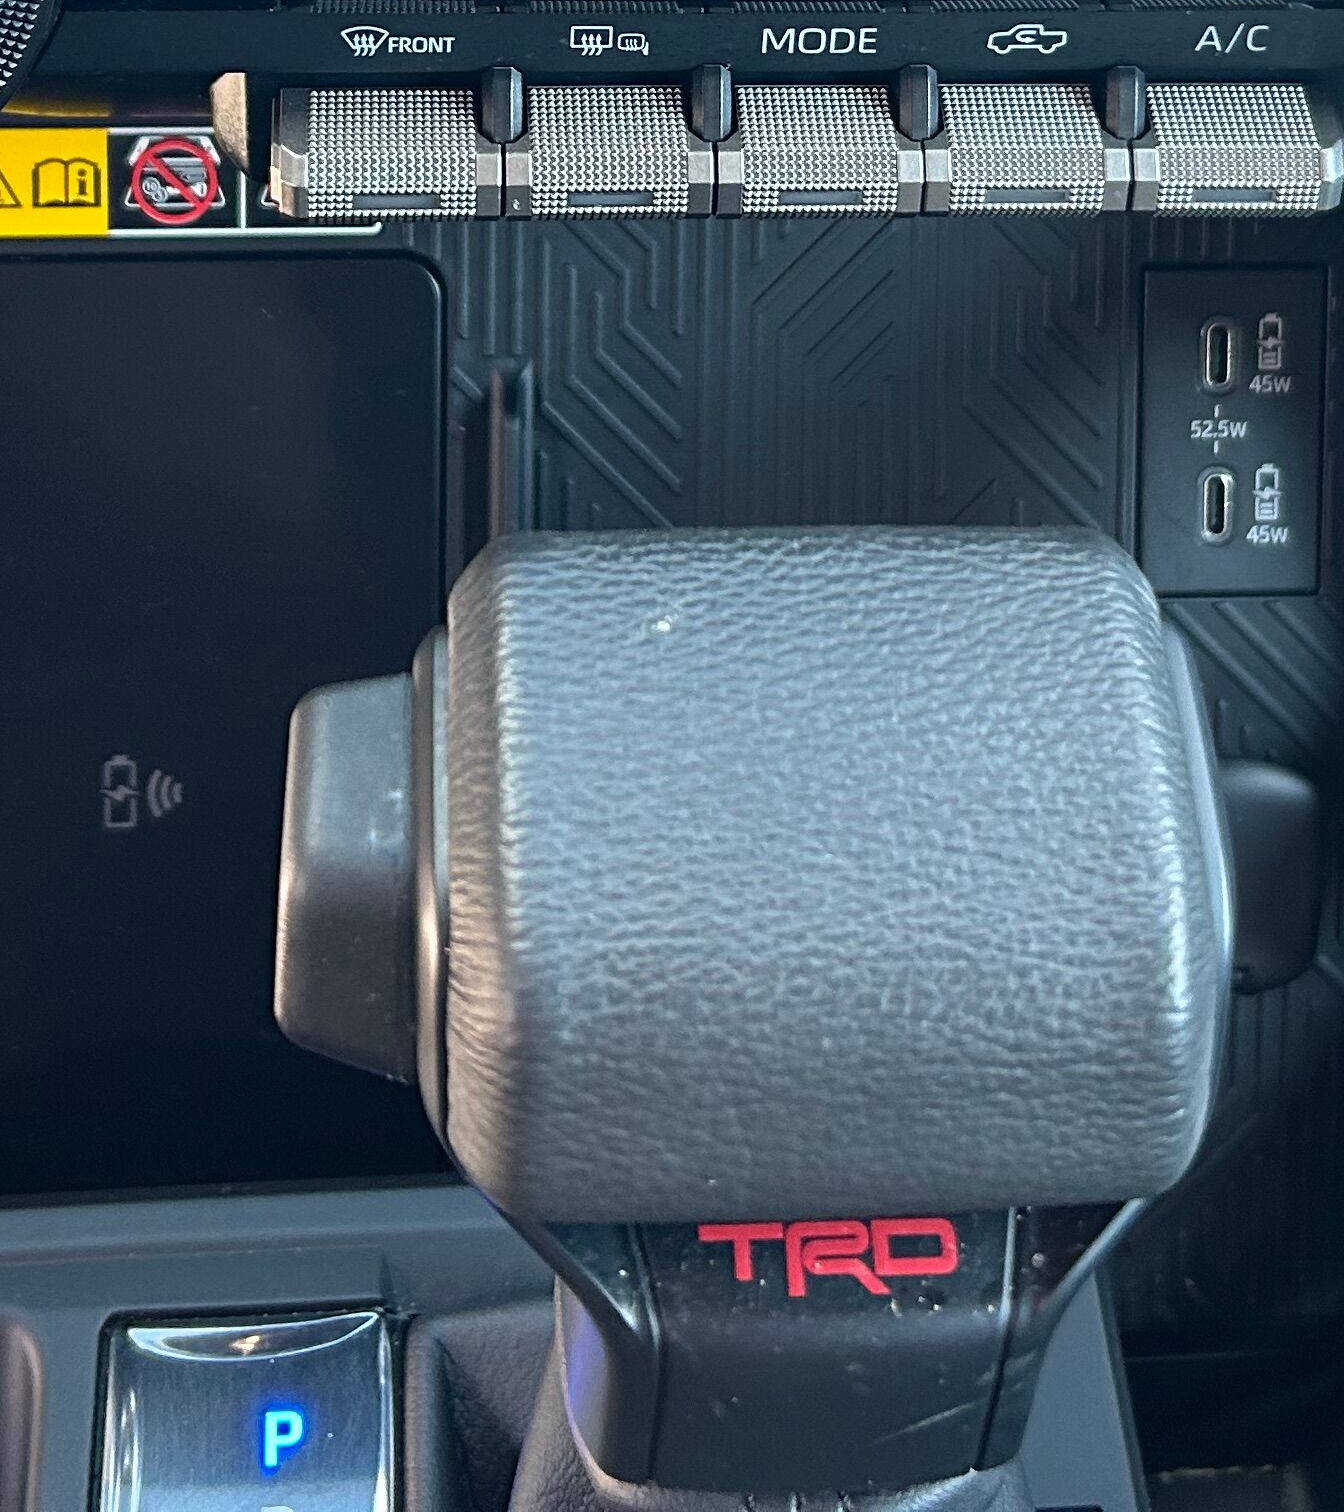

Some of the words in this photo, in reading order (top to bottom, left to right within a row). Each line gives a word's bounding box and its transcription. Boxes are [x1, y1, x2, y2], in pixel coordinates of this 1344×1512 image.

[388, 36, 456, 53] FRONT
[761, 27, 878, 54] MODE
[1194, 24, 1270, 52] A/C
[1248, 375, 1292, 393] 45W
[1190, 419, 1248, 439] 52.5W
[1246, 525, 1290, 543] 45W
[698, 1217, 958, 1298] TRD
[264, 1409, 304, 1469] P
